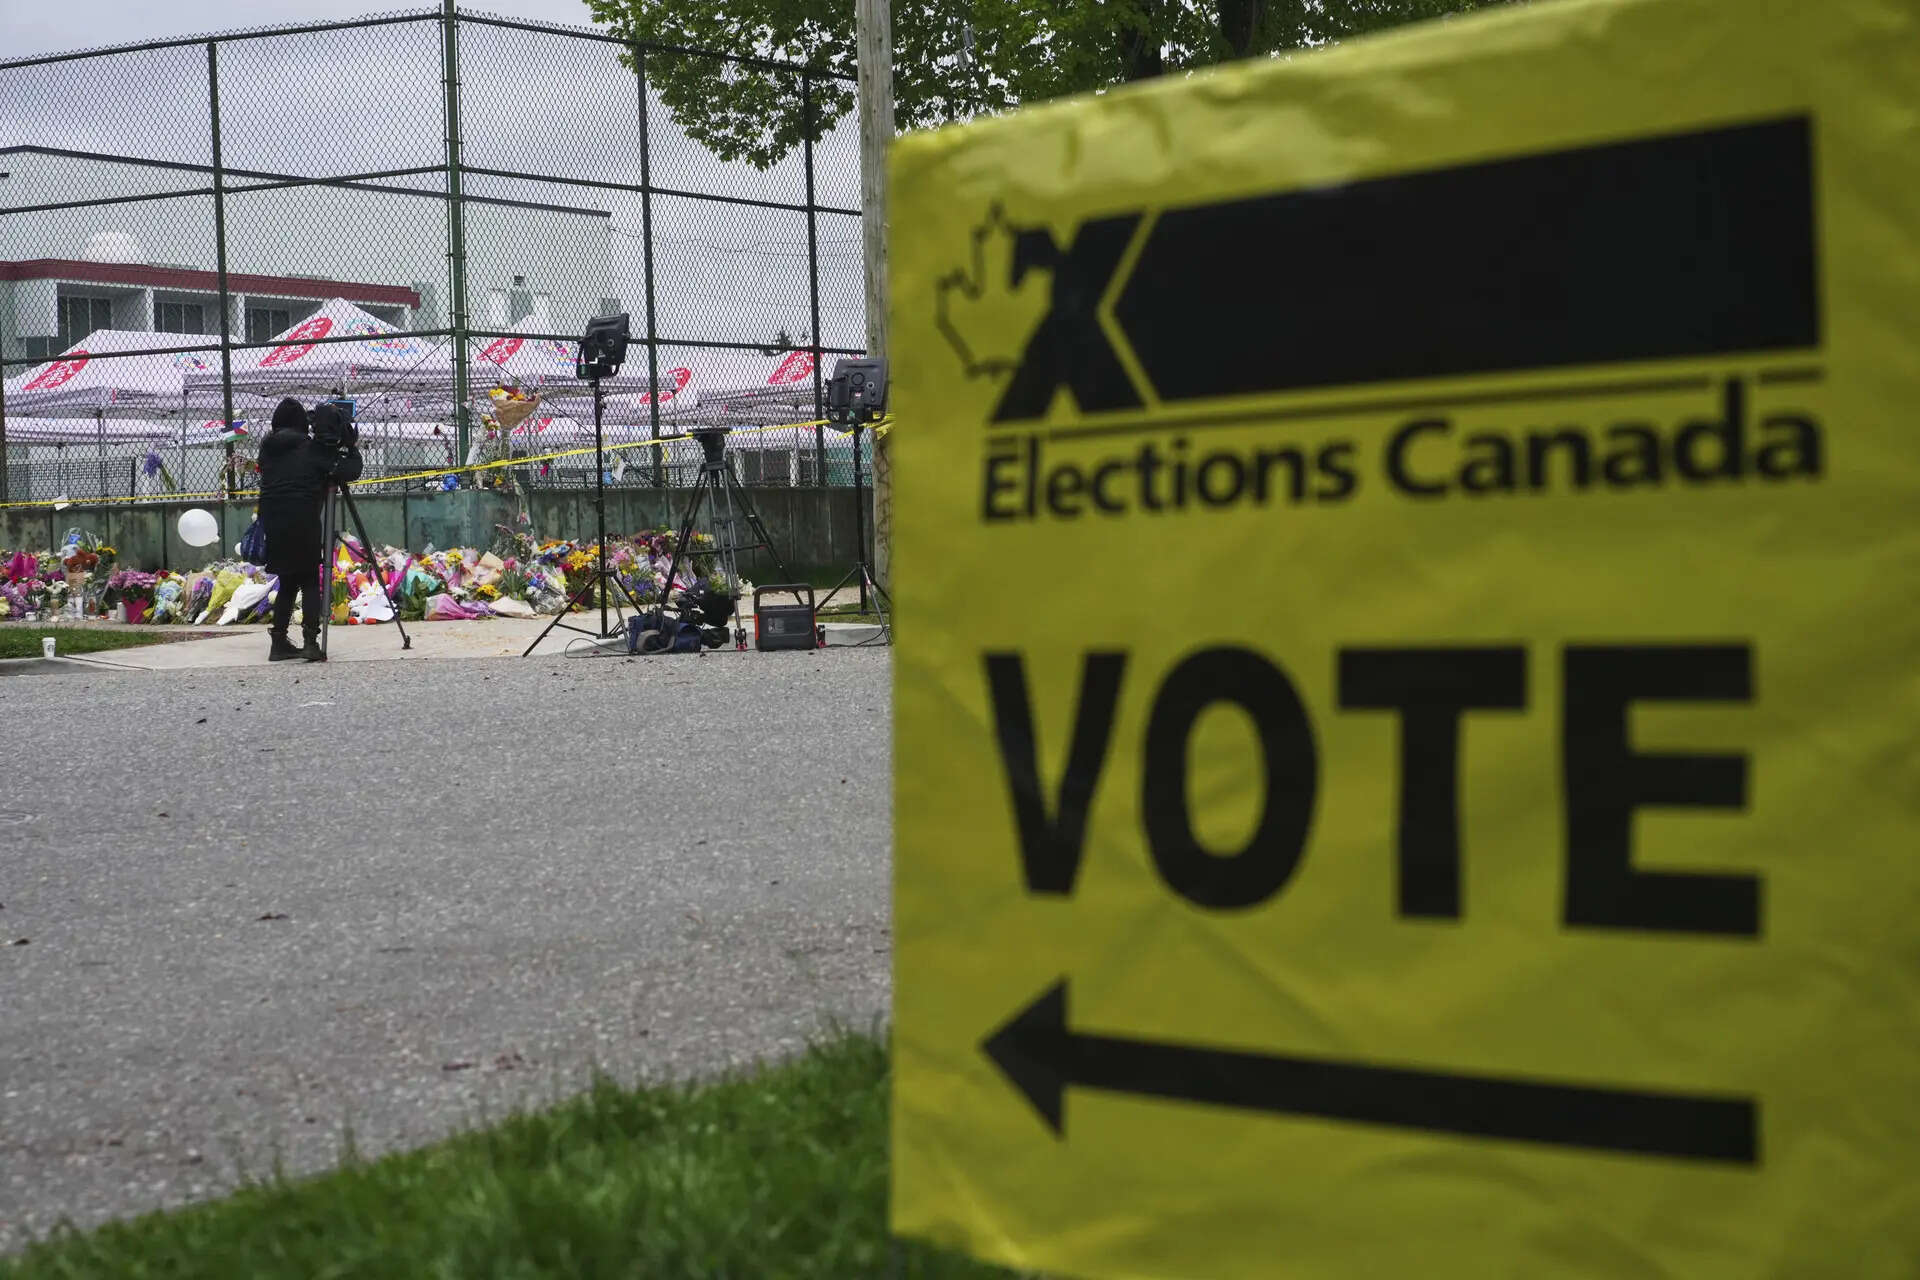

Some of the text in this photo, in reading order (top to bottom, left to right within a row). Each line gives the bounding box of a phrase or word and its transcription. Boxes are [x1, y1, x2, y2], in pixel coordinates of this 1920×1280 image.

[984, 376, 1822, 522] Elections Canada
[983, 643, 1763, 940] VOTE
